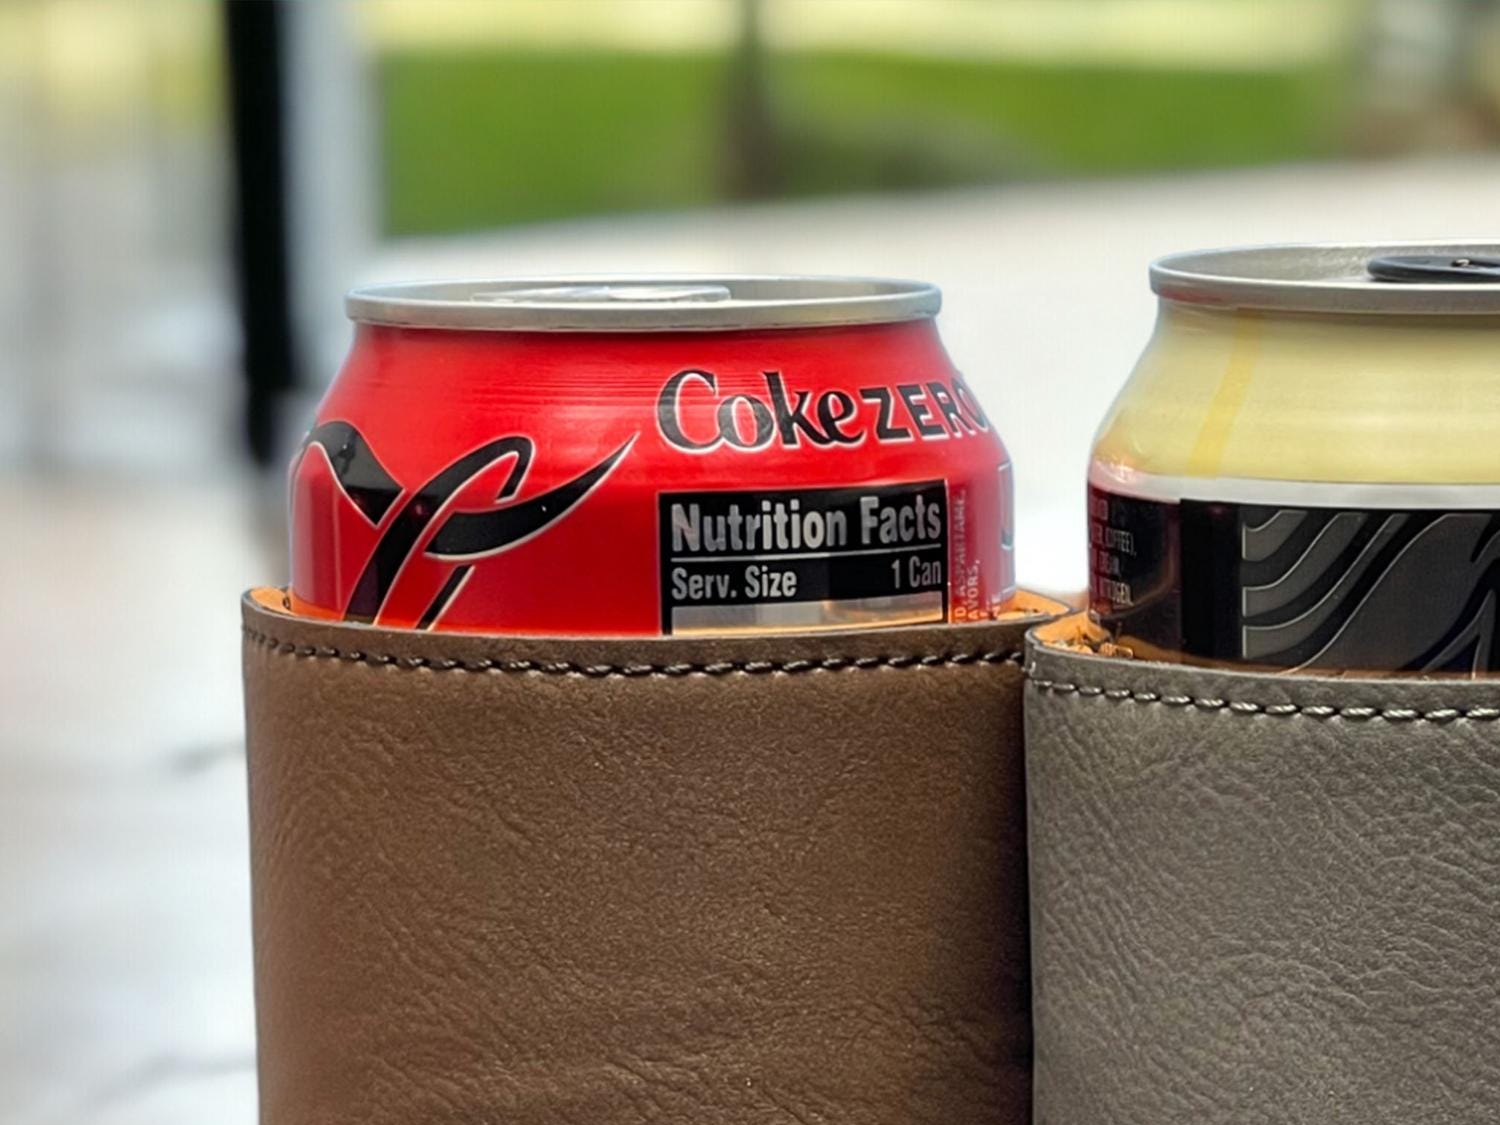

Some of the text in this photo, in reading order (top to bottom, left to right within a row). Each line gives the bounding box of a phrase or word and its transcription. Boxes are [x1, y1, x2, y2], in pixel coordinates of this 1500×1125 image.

[670, 494, 942, 552] Nutrition Facts
[671, 555, 942, 600] Serv. Size 1 Can
